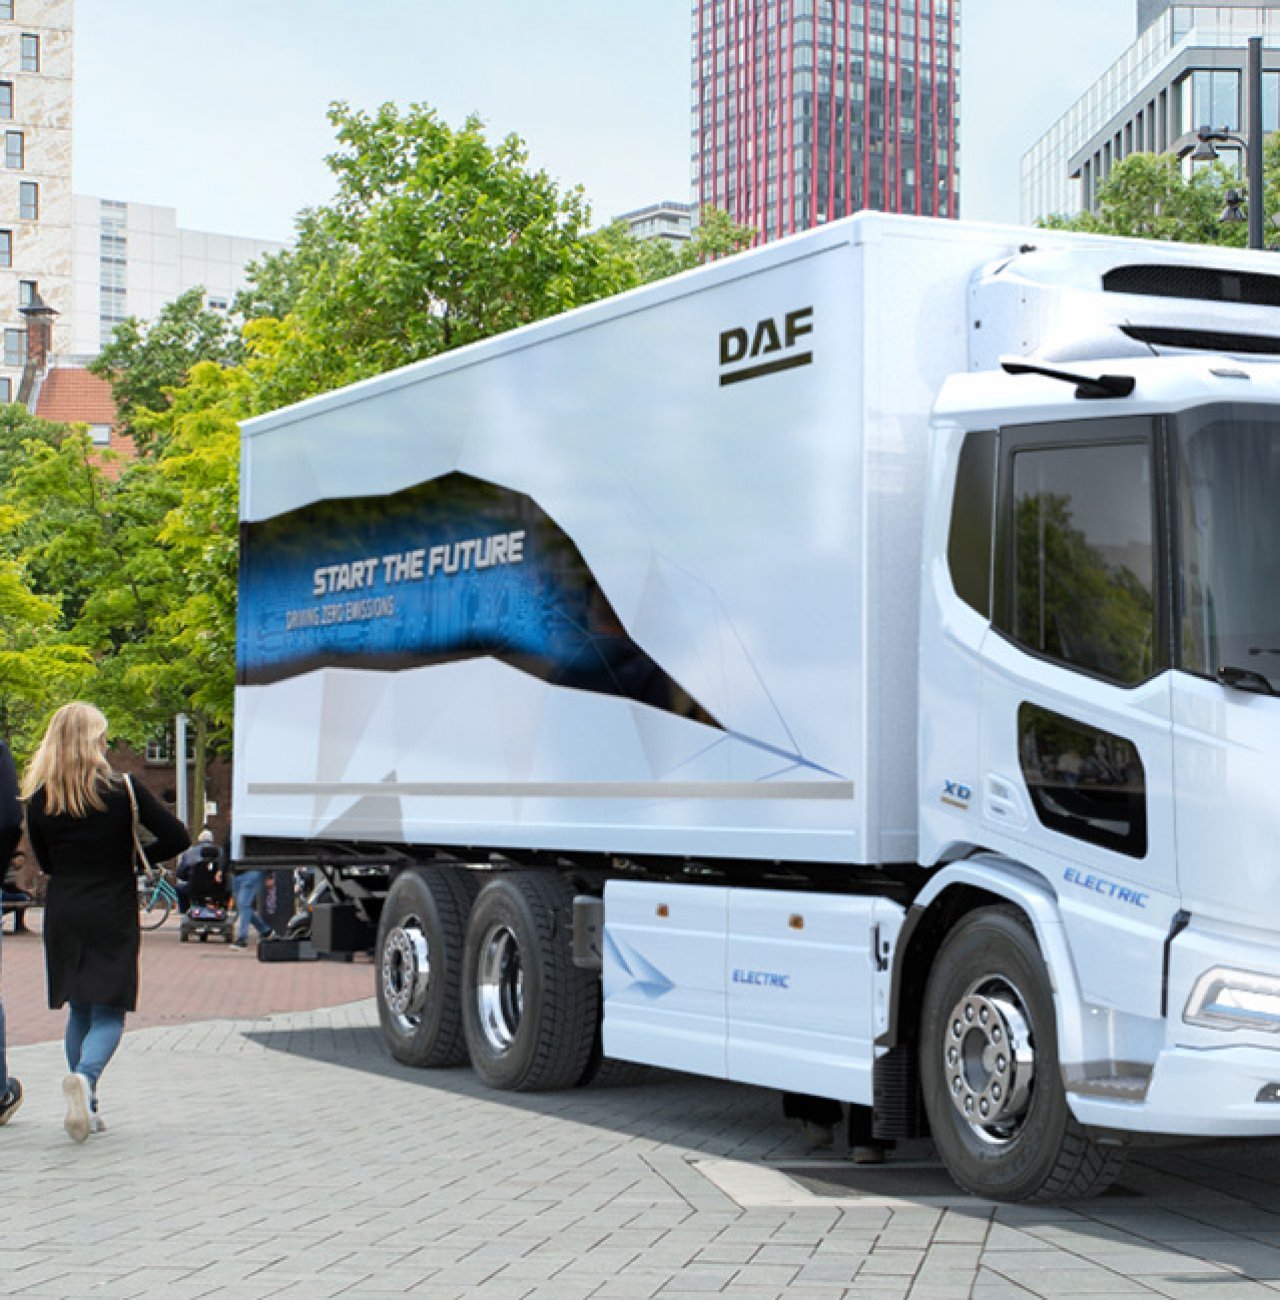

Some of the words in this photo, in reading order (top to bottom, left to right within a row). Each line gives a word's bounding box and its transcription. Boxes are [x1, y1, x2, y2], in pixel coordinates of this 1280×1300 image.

[720, 305, 813, 365] DAF
[313, 558, 379, 595] START
[382, 550, 425, 583] THE
[428, 530, 525, 576] FUTURE
[944, 779, 970, 799] XD
[1064, 867, 1149, 908] ELECTRIC
[732, 969, 790, 988] ELECTRIC
